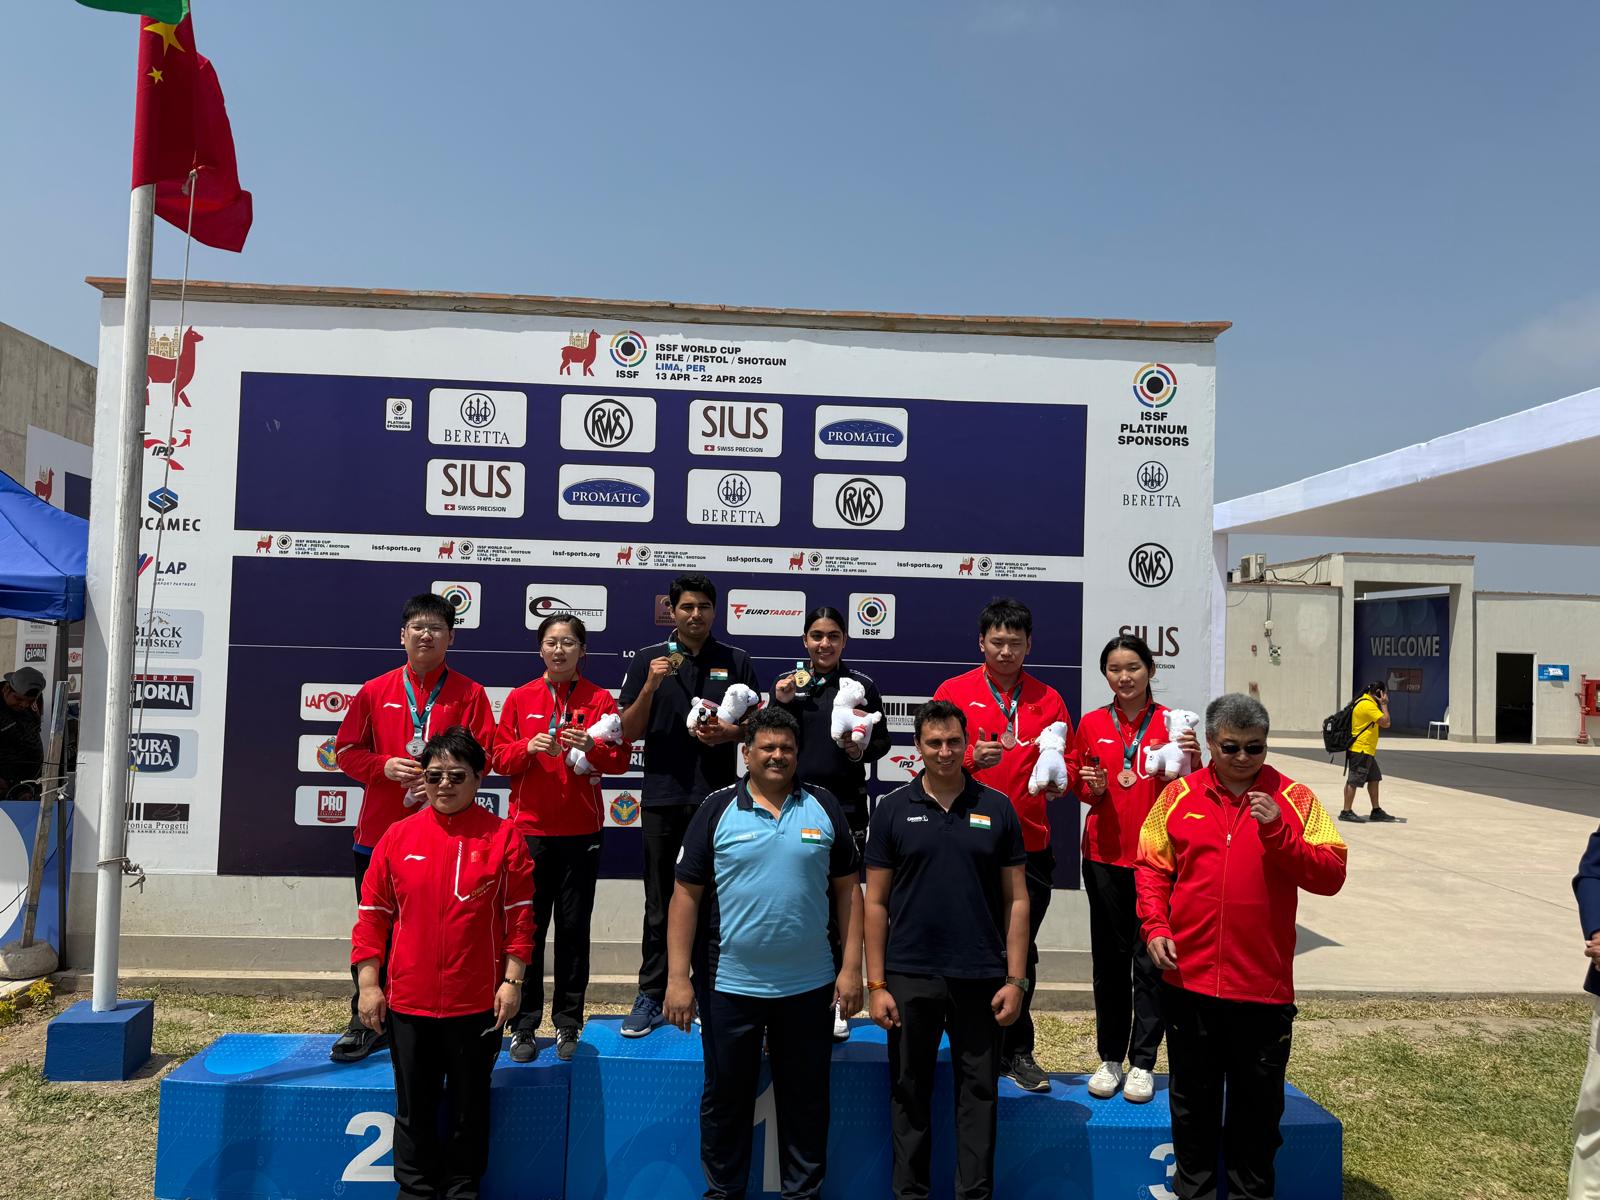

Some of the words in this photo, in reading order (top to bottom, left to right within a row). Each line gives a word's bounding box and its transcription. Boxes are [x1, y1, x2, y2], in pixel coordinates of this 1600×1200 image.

[656, 344, 678, 352] ISSF
[681, 345, 717, 354] WORLD
[720, 346, 741, 354] CUP
[656, 354, 684, 362] RIFLE
[692, 355, 728, 364] PISTOL
[738, 356, 787, 366] SHOTGUN
[616, 370, 639, 378] ISSF
[656, 364, 683, 372] LIMA,
[670, 373, 691, 381] APR
[716, 375, 736, 383] APR
[738, 376, 762, 384] 2025
[702, 405, 768, 440] SIUS
[1141, 412, 1168, 421] ISSF
[591, 406, 626, 443] RWS
[1120, 424, 1187, 435] PLATINUM
[444, 429, 510, 444] BERETTA
[828, 431, 894, 443] PROMATIC
[1118, 435, 1189, 447] SPONSORS
[152, 446, 175, 456] IPD
[442, 463, 512, 498] SIUS
[572, 491, 641, 504] PROMATIC
[843, 486, 876, 522] RWS
[1123, 494, 1180, 507] BERETTA
[702, 509, 765, 524] BERETTA
[140, 517, 201, 531] CAMEC
[372, 544, 421, 553] issf-sports.org
[552, 550, 600, 559] issf-sports.org
[727, 555, 773, 564] issf-sports.org
[897, 562, 943, 570] issf-sports.org
[157, 561, 187, 574] LAP
[1136, 550, 1166, 583] RWS
[1371, 636, 1440, 656] WELCOME
[26, 649, 45, 660] GLORIA
[131, 684, 189, 707] LORIA
[131, 750, 174, 766] VIDA
[321, 796, 343, 810] PRO
[156, 822, 189, 830] Progetti
[753, 1081, 781, 1192] 1
[341, 1112, 396, 1182] 2
